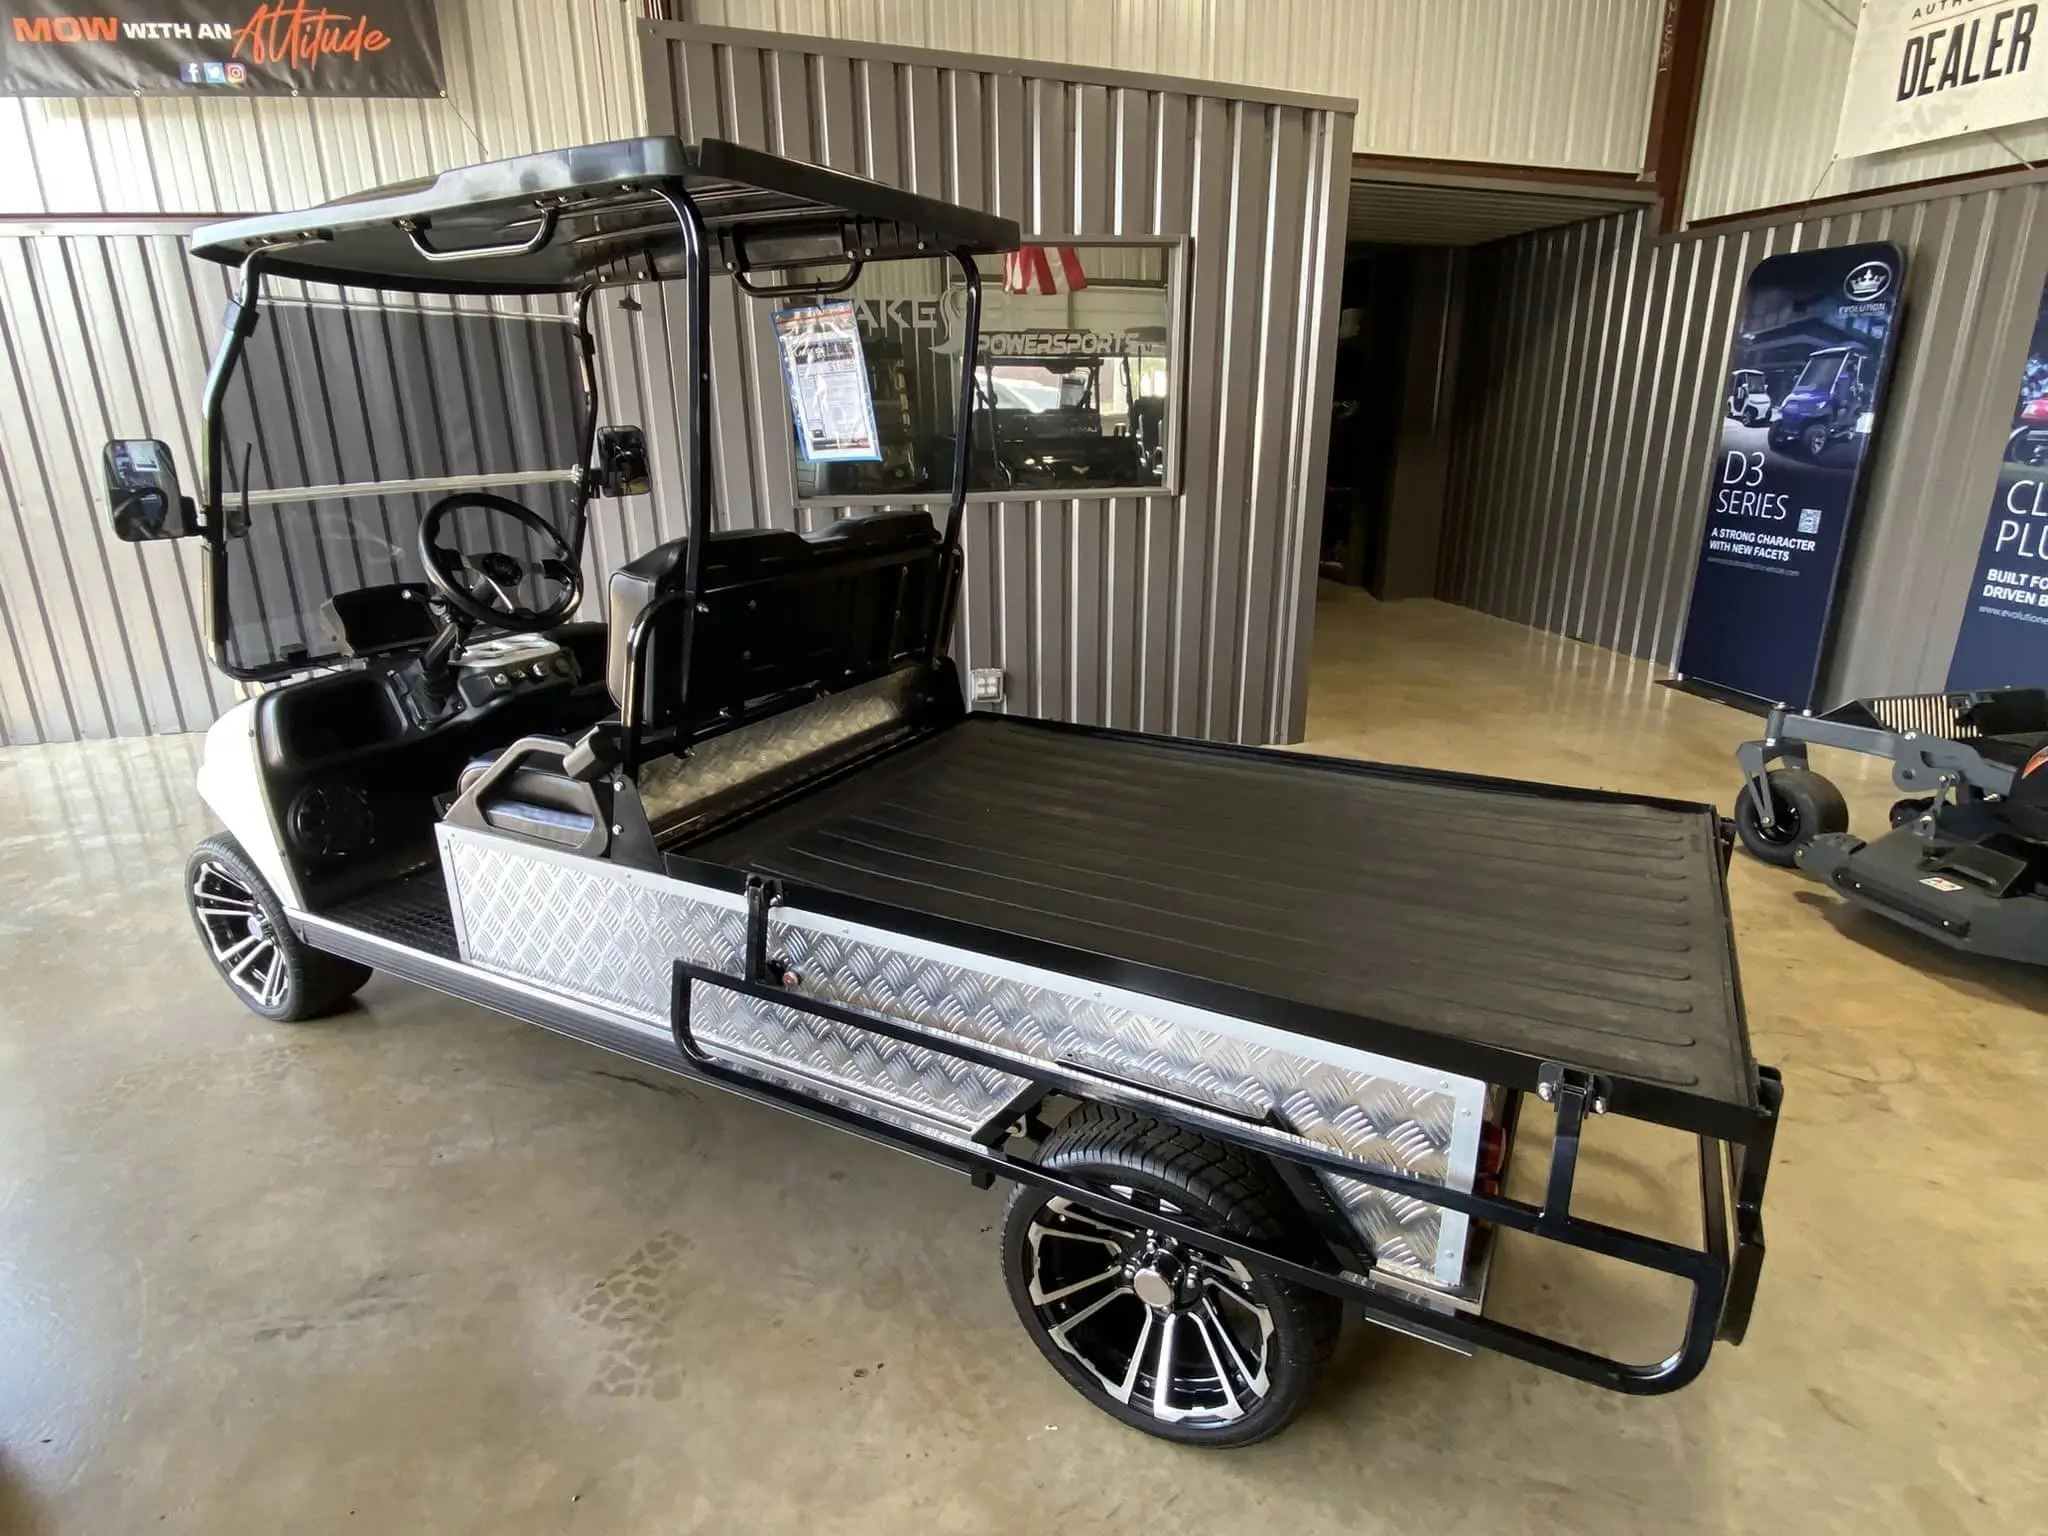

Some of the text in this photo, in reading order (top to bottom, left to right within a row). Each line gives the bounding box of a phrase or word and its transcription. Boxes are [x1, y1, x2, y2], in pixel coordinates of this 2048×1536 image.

[12, 0, 391, 72] MOW WITH AN Attitude
[1896, 3, 2039, 102] DEALER
[846, 297, 938, 329] AKE
[978, 331, 1140, 355] POWERSPORTS
[1723, 450, 1765, 487] D3
[1716, 489, 1790, 520] SERIES
[1709, 539, 1790, 562] WITH NEW FACETS
[1711, 527, 1816, 552] A STRONG CHARACTER
[1987, 568, 2029, 587] BUILT
[1982, 584, 2036, 606] DRIVEN
